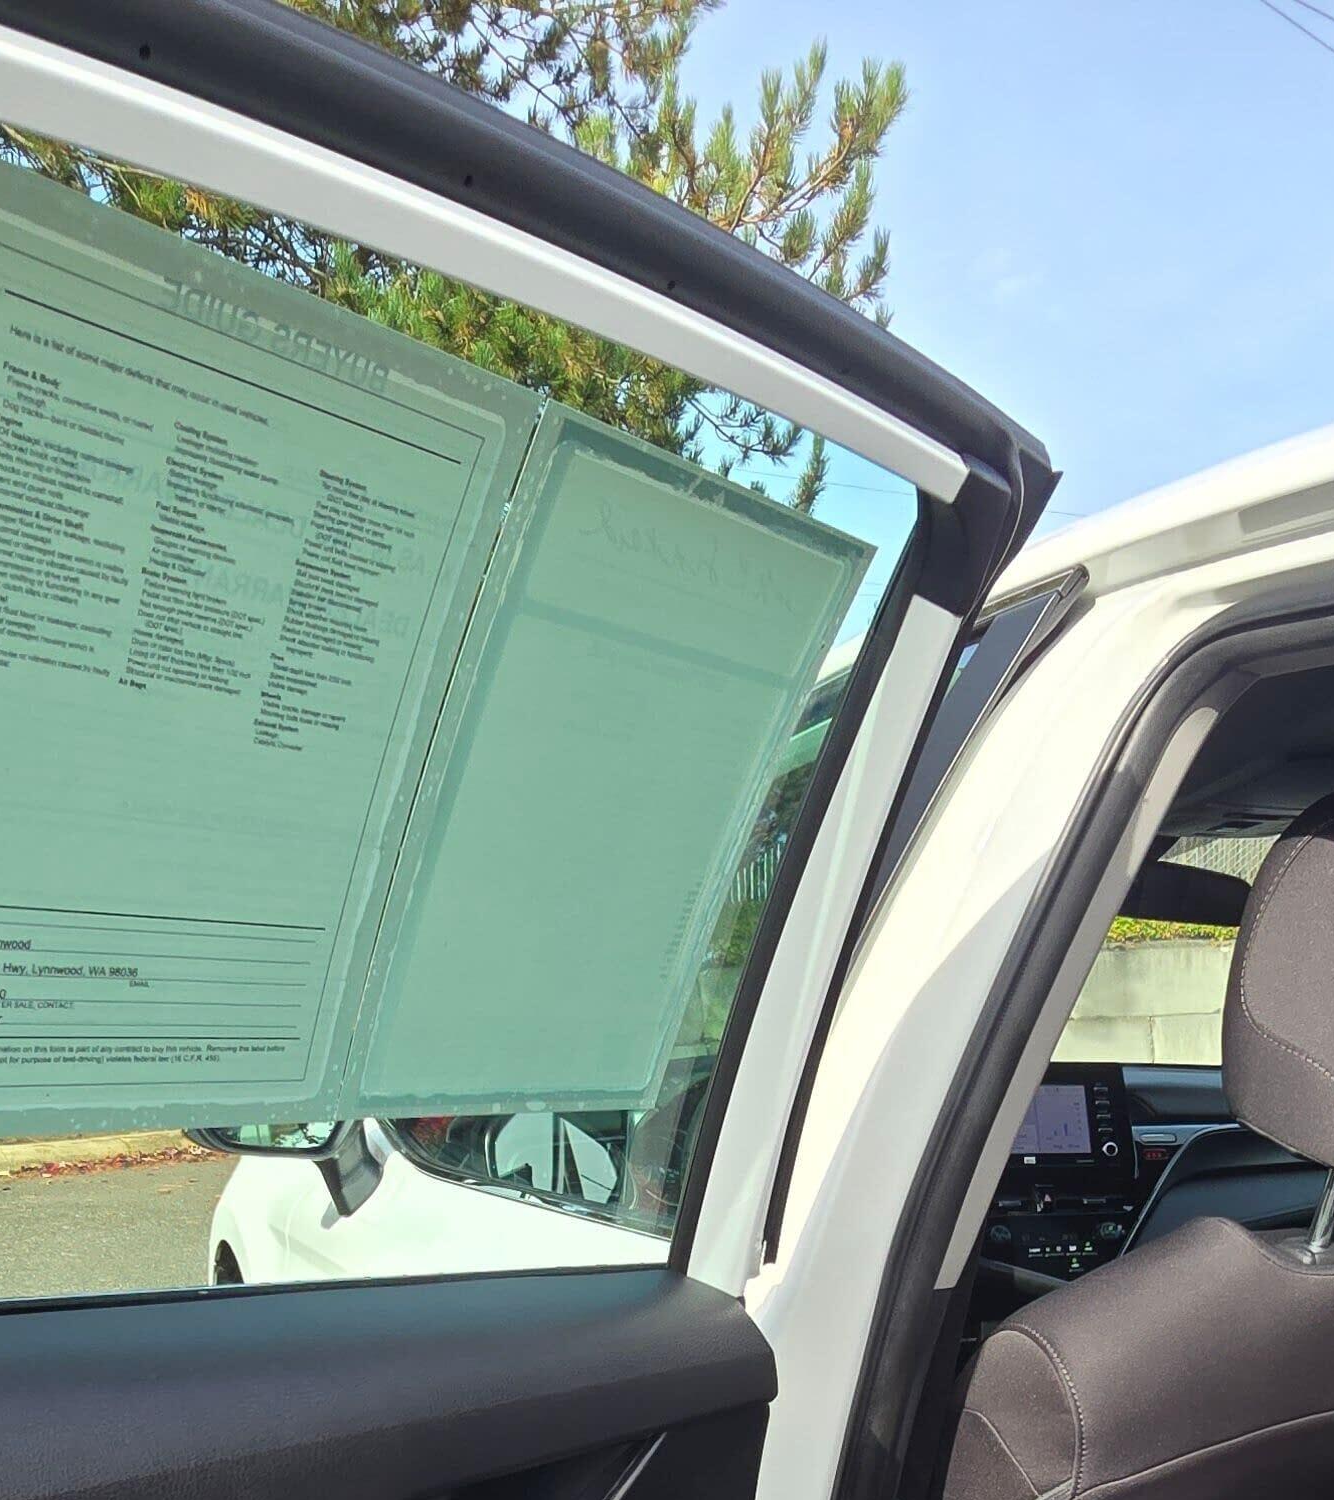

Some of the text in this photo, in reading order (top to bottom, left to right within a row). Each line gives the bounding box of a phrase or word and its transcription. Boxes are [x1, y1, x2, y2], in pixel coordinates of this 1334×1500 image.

[2, 360, 29, 377] Frame
[38, 372, 60, 390] Body
[3, 963, 28, 976] Hwy,
[32, 965, 84, 976] Lynnwood,
[89, 967, 107, 977] WA
[109, 967, 138, 977] 98036
